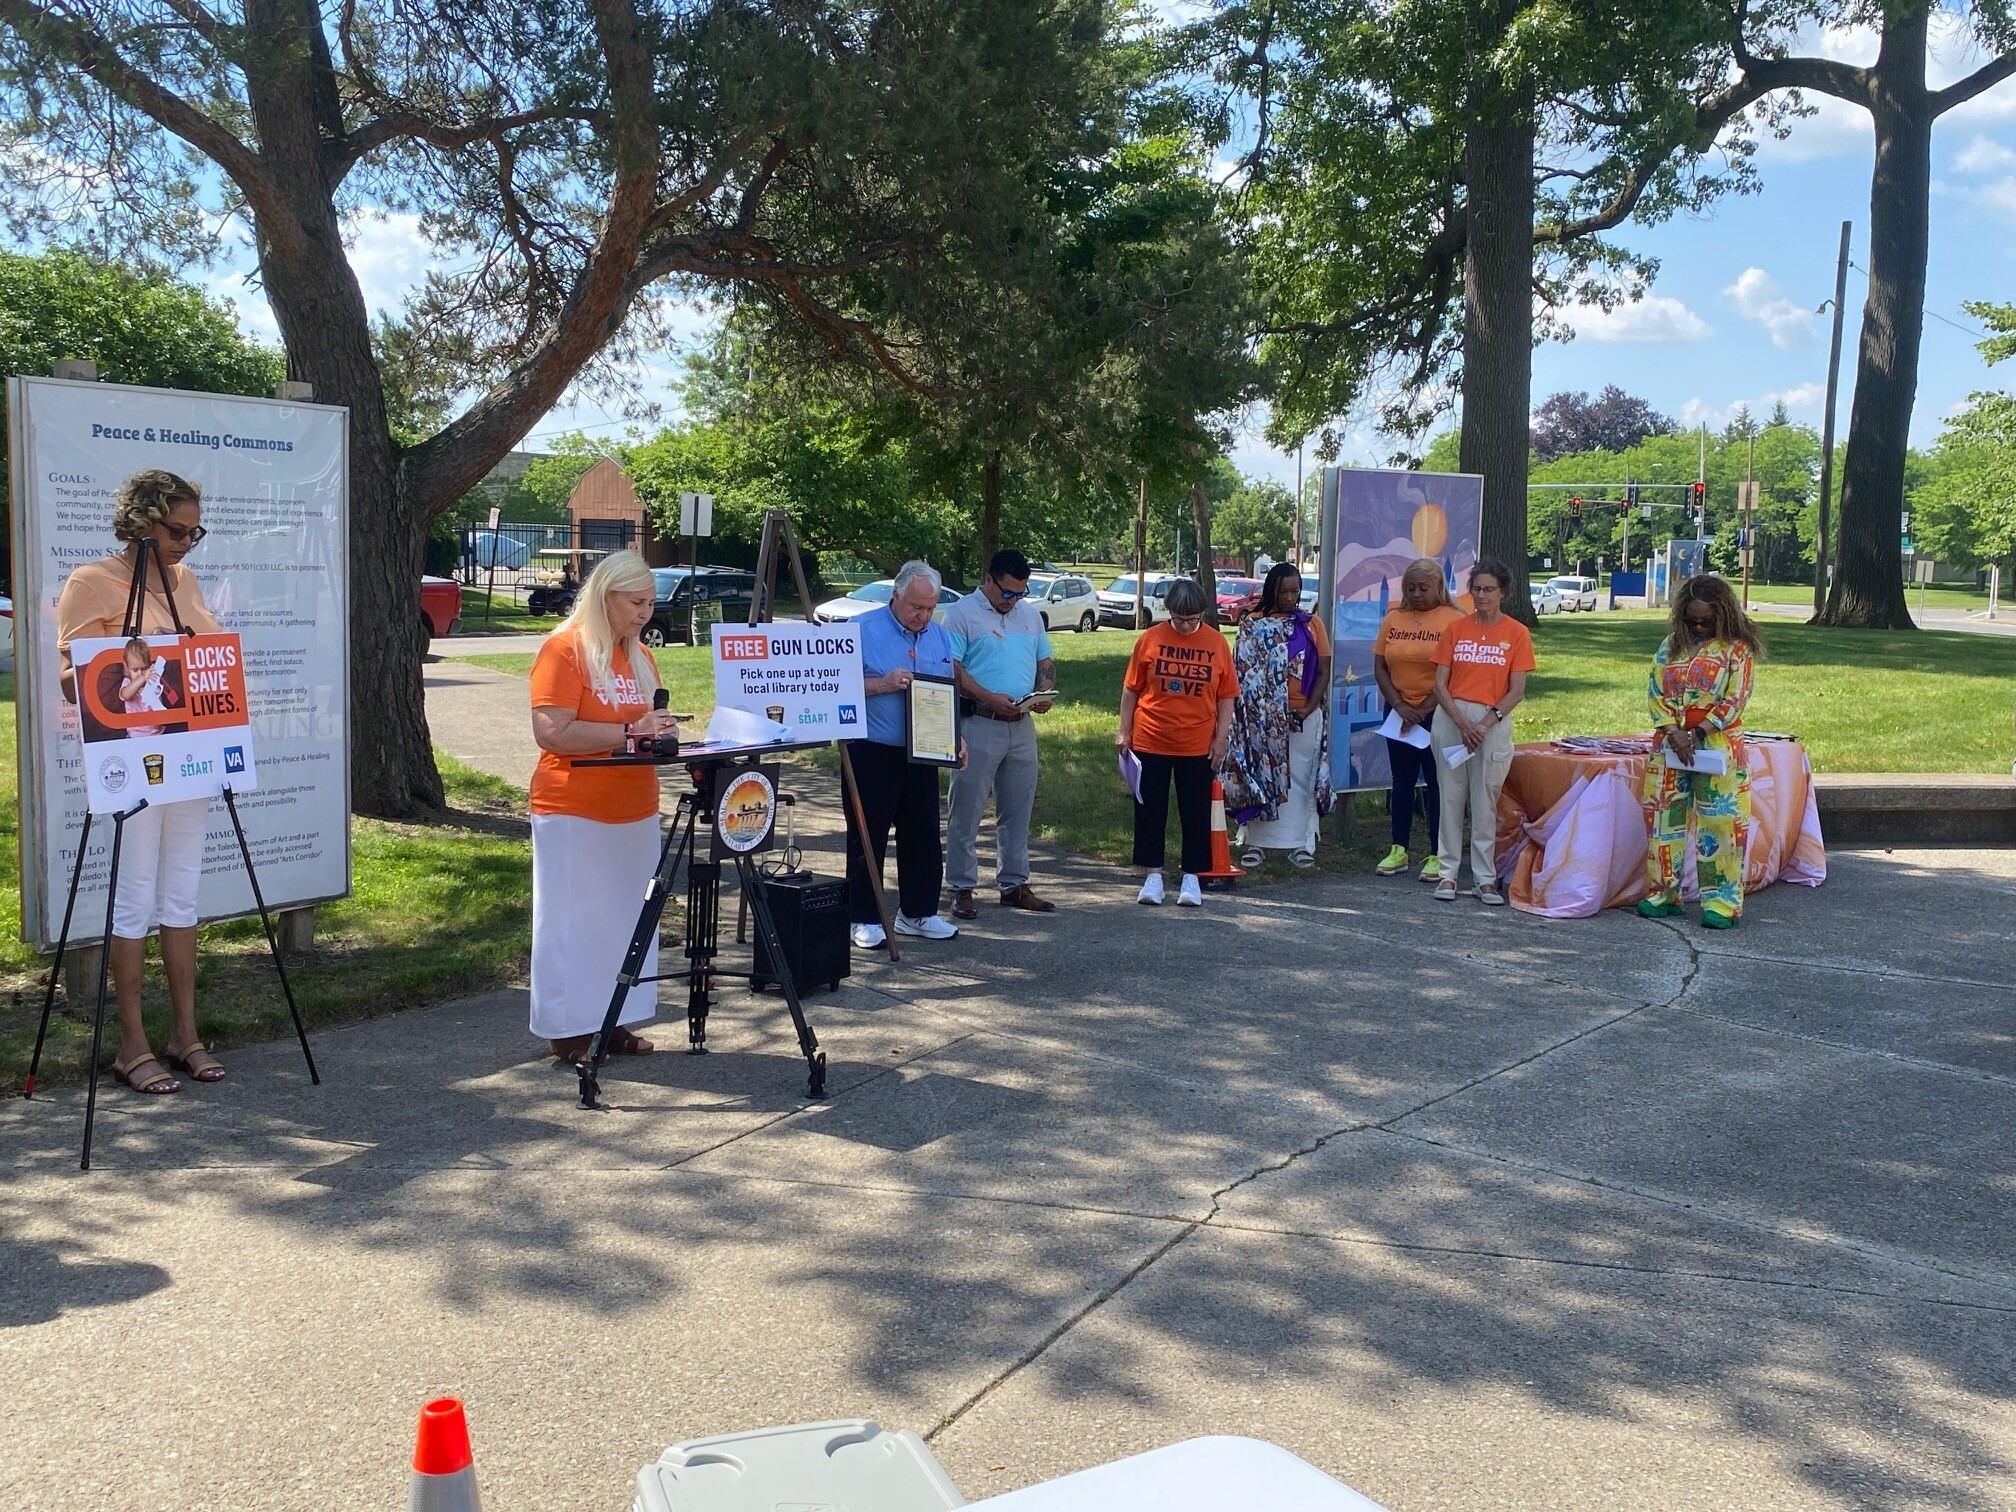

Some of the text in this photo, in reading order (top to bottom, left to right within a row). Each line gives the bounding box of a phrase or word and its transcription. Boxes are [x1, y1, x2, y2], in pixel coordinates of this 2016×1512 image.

[92, 424, 294, 452] Peace & Healing Commons
[49, 472, 90, 484] GOALS
[56, 487, 71, 497] The
[72, 489, 90, 498] goal
[91, 489, 99, 497] of
[215, 496, 228, 504] safe
[56, 501, 103, 510] community,
[205, 506, 219, 514] and
[220, 507, 245, 515] elevate
[281, 509, 289, 517] of
[56, 512, 70, 520] We
[70, 512, 92, 521] hope
[93, 513, 102, 521] to
[203, 516, 224, 525] which
[225, 518, 249, 527] people
[263, 518, 278, 528] gain
[56, 524, 72, 532] and
[73, 524, 95, 533] hope
[96, 524, 115, 533] from
[212, 528, 240, 536] violence
[51, 546, 102, 557] MISSION
[57, 561, 72, 569] The
[205, 563, 240, 572] non-profit
[299, 565, 325, 573] promote
[238, 609, 253, 617] land
[255, 609, 262, 617] or
[263, 609, 293, 617] resources
[225, 619, 233, 627] of
[285, 618, 316, 627] gathering
[1388, 627, 1441, 643] Sisters4Unit
[271, 648, 307, 657] permanent
[724, 638, 855, 657] FREE GUN LOCKS
[1158, 644, 1216, 663] TRINITY
[1454, 642, 1478, 653] end
[185, 645, 236, 669] LOCKS
[246, 657, 305, 667] reflect, find solace,
[1453, 651, 1506, 666] violence
[264, 668, 297, 676] tomorrow.
[740, 667, 841, 682] Pick one up at your
[1159, 661, 1209, 679] LOVES
[188, 670, 229, 693] SAVE
[743, 681, 840, 695] local library today
[282, 687, 293, 695] not
[294, 686, 308, 695] only
[191, 693, 240, 717] LIVES.
[264, 698, 295, 706] tomorrow
[296, 696, 305, 704] for
[62, 721, 76, 729] the
[263, 706, 291, 716] different
[310, 705, 318, 713] of
[798, 713, 828, 724] SMART
[840, 709, 856, 720] VA
[56, 758, 82, 769] THE
[63, 775, 79, 784] The
[272, 756, 281, 765] by
[281, 755, 301, 763] Peace
[306, 752, 330, 761] Healing
[226, 752, 243, 768] VA
[180, 760, 214, 777] SMART
[63, 786, 82, 795] with
[72, 810, 79, 818] is
[241, 791, 249, 799] to
[250, 790, 266, 798] work
[267, 786, 298, 798] alongside
[298, 784, 316, 793] those
[215, 804, 225, 813] for
[251, 800, 264, 808] and
[265, 797, 297, 809] possibility
[204, 845, 216, 853] the
[217, 841, 240, 851] Toledo
[269, 836, 277, 844] of
[277, 835, 288, 843] Art
[306, 831, 320, 841] part
[80, 871, 107, 882] oledo's
[256, 849, 265, 857] be
[266, 846, 283, 856] easily
[284, 842, 312, 852] accessed
[87, 883, 97, 892] all
[200, 866, 217, 875] west
[217, 863, 231, 873] end
[231, 862, 240, 871] of
[252, 858, 279, 868] planned
